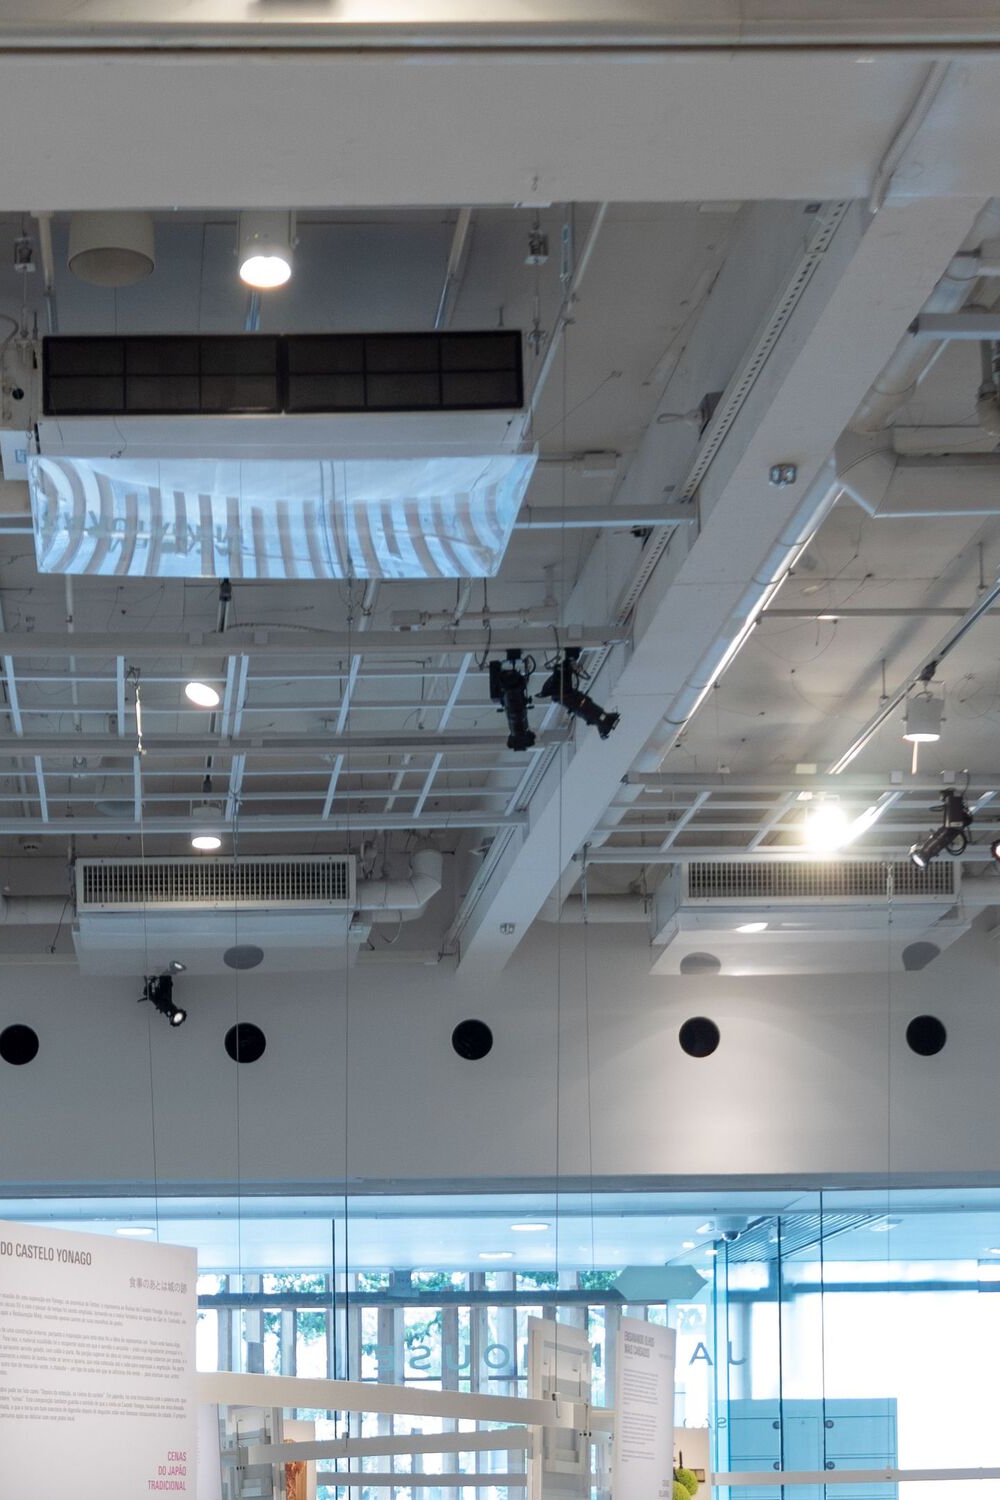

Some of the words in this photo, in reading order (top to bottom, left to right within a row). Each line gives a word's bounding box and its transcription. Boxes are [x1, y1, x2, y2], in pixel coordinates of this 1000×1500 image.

[0, 1241, 13, 1256] DO
[16, 1243, 54, 1262] CASTELO
[56, 1248, 92, 1266] YONAGO
[167, 1451, 187, 1461] CENAS
[158, 1465, 166, 1476] DO
[168, 1464, 187, 1476] JAPÃO
[147, 1480, 186, 1491] TRADICIONAL
